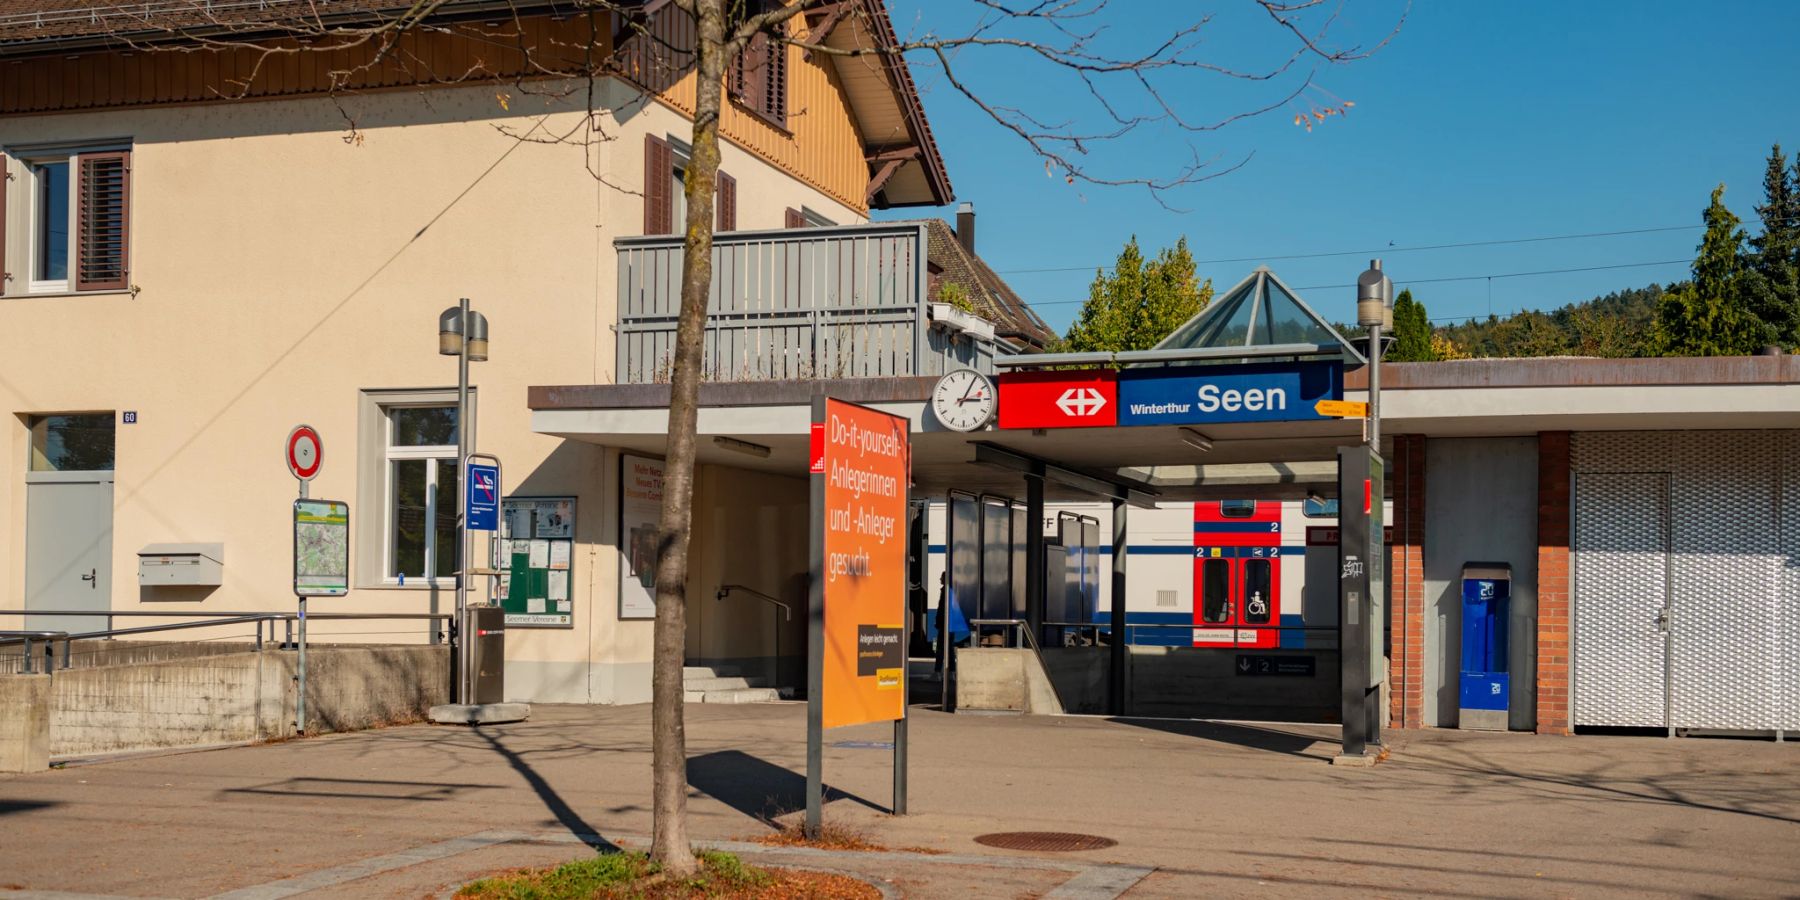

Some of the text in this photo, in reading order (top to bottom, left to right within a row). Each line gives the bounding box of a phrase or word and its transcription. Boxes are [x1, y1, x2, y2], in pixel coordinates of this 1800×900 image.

[1130, 384, 1286, 415] Winterthur Seen
[124, 412, 135, 422] 60
[831, 413, 902, 458] Do-it-yourself-
[829, 457, 897, 500] Anlegerinnen
[830, 501, 896, 545] und -Anleger
[1270, 522, 1279, 533] 2
[1196, 547, 1205, 558] 2
[1270, 547, 1279, 558] 2
[829, 546, 872, 583] gesucht.
[1261, 661, 1270, 673] 2
